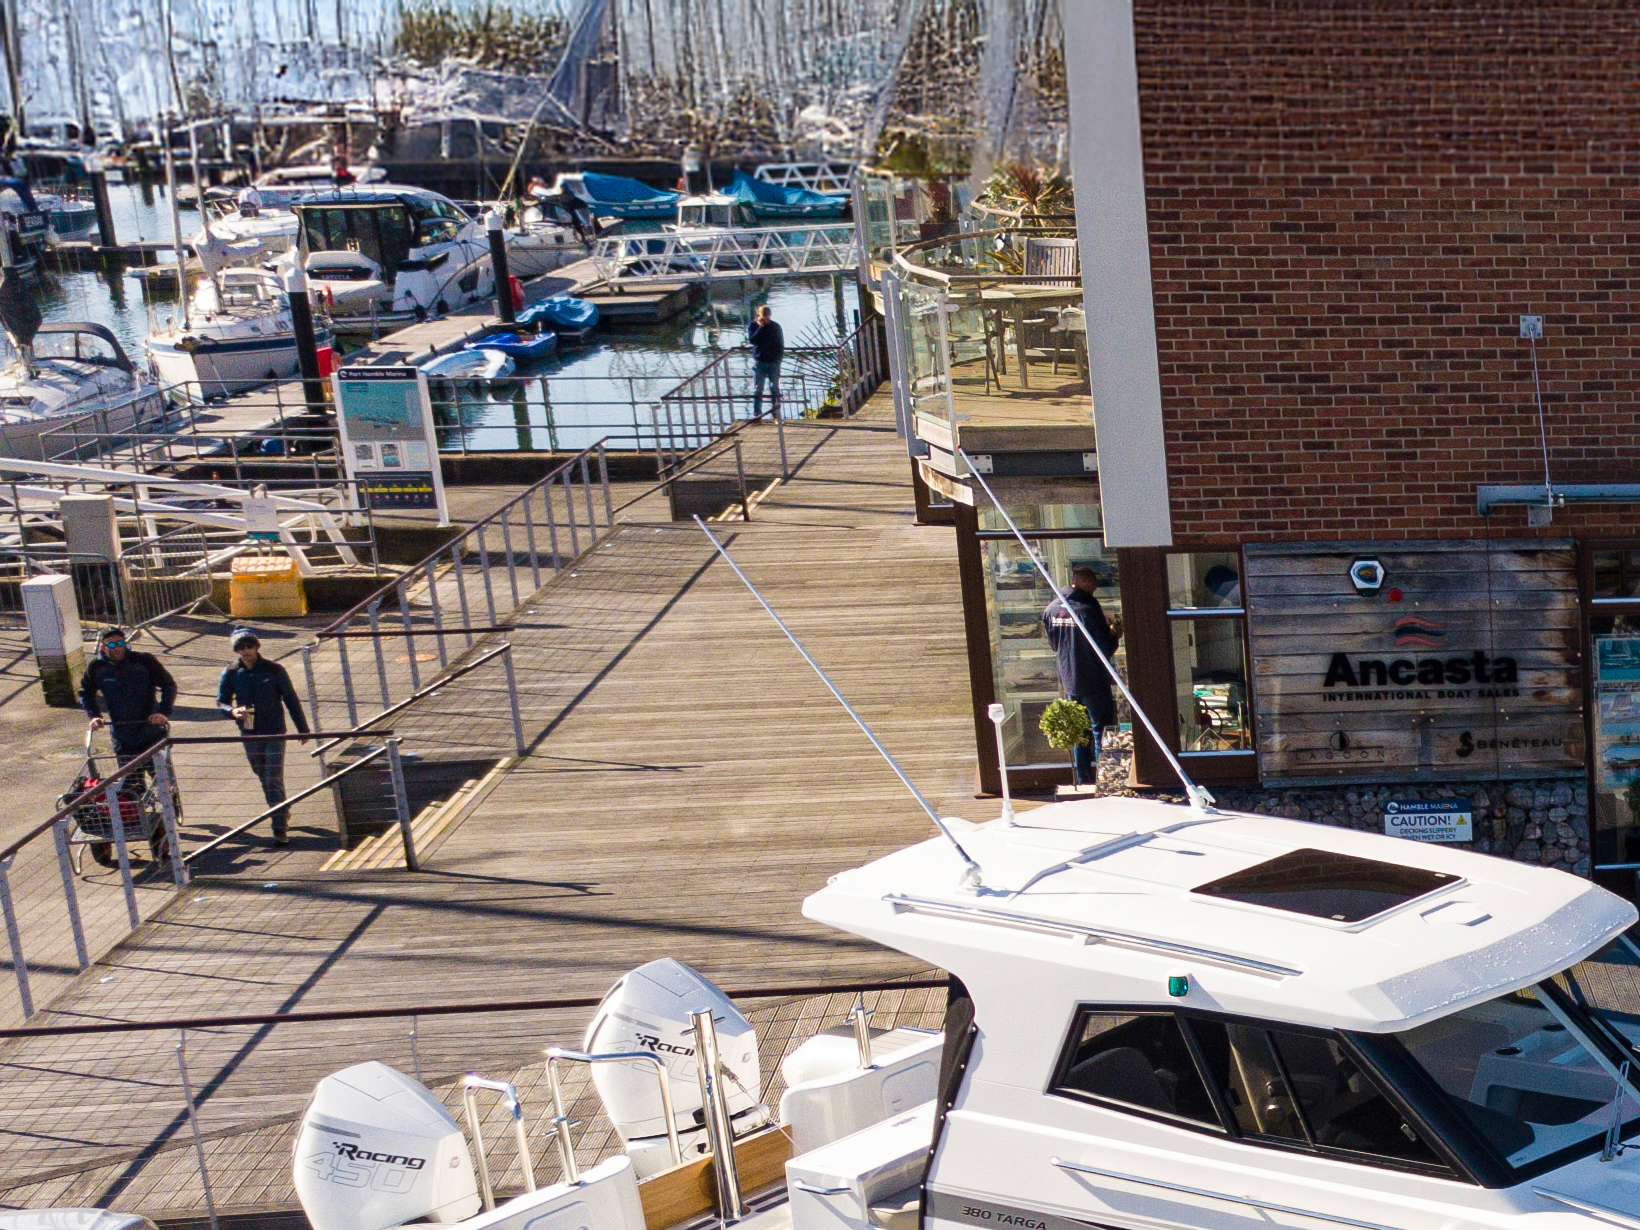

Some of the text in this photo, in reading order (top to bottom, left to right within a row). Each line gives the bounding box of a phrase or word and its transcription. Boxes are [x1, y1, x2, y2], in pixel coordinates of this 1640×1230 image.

[1323, 650, 1519, 687] Ancasta
[1323, 688, 1520, 702] INTERNATIONAL BOAT SALES
[1295, 750, 1385, 761] LAGOON
[1400, 802, 1458, 811] HAMBLE MARINA
[1390, 815, 1451, 826] CAUTION!
[635, 1033, 695, 1057] Raci
[333, 1141, 426, 1170] Racing
[303, 1151, 420, 1195] 450
[961, 1205, 992, 1220] 380
